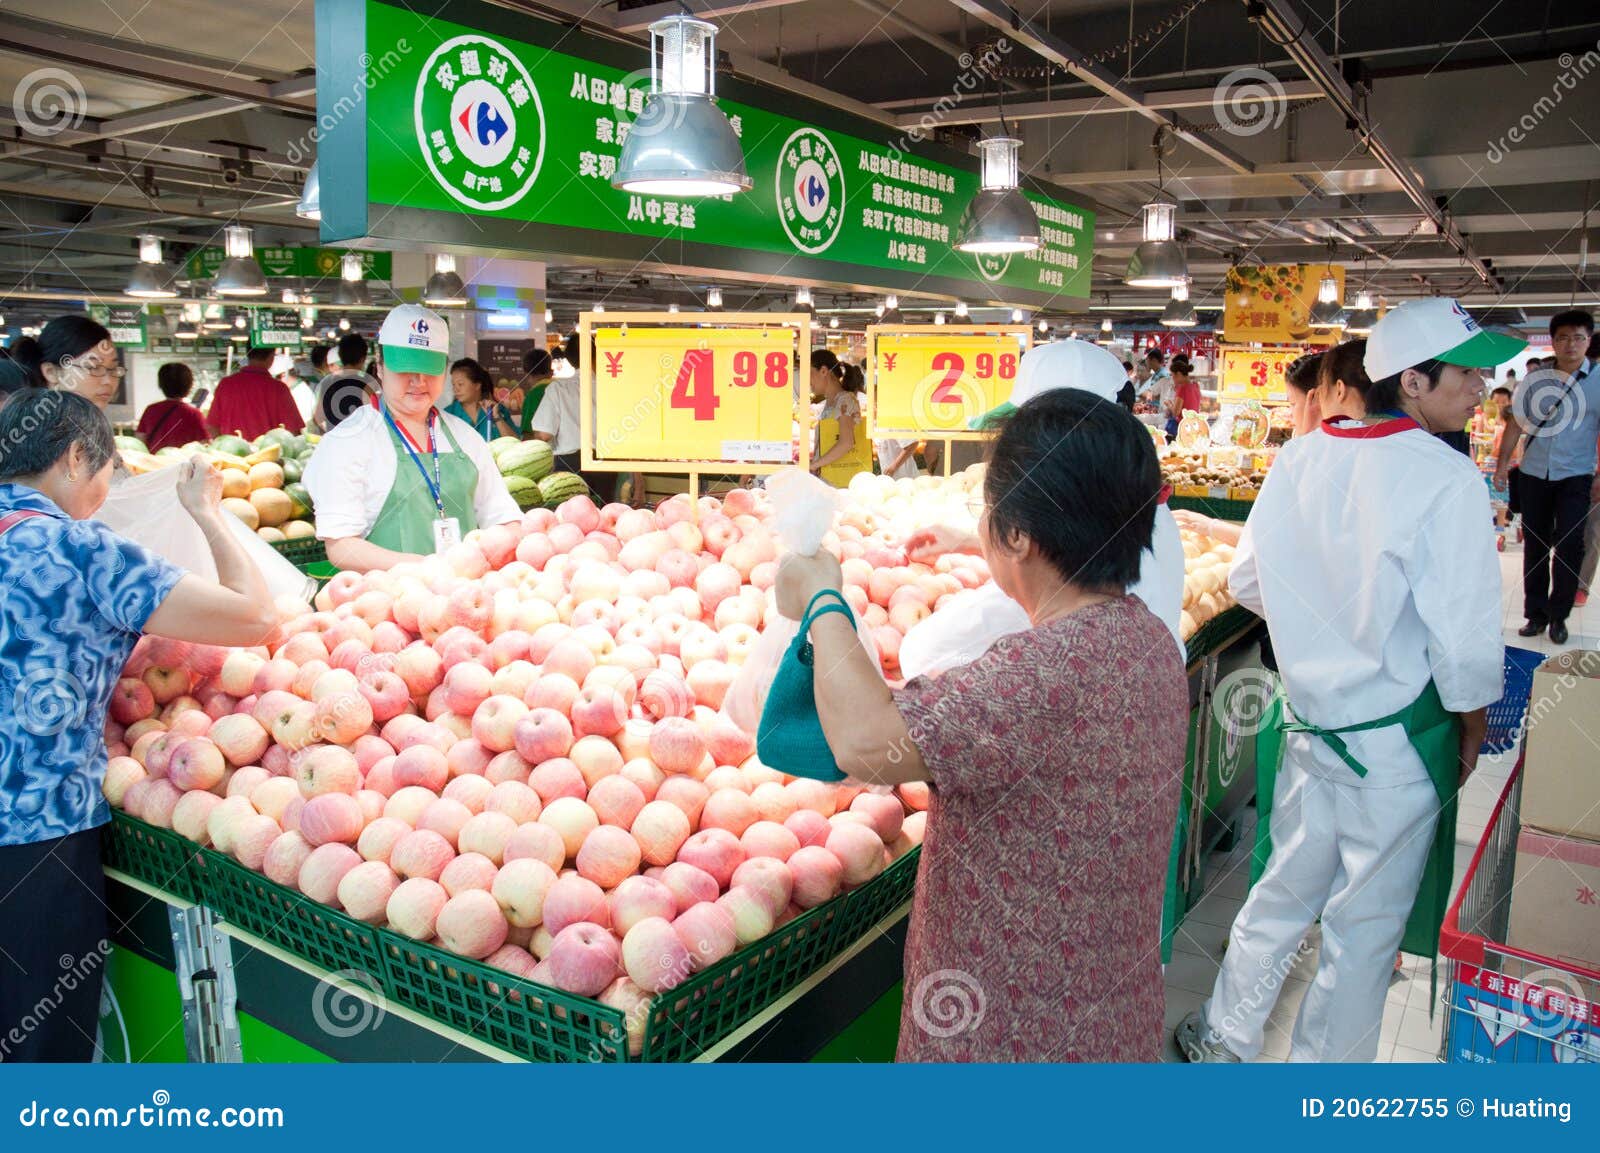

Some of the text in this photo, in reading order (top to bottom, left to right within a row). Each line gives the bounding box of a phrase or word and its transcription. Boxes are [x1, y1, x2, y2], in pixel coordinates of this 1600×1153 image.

[570, 72, 653, 114] 从田地直
[627, 195, 696, 229] 从中受益
[887, 240, 927, 264] 从中受益
[604, 351, 625, 378] ¥
[883, 352, 898, 372] ¥
[1576, 885, 1596, 905] 水
